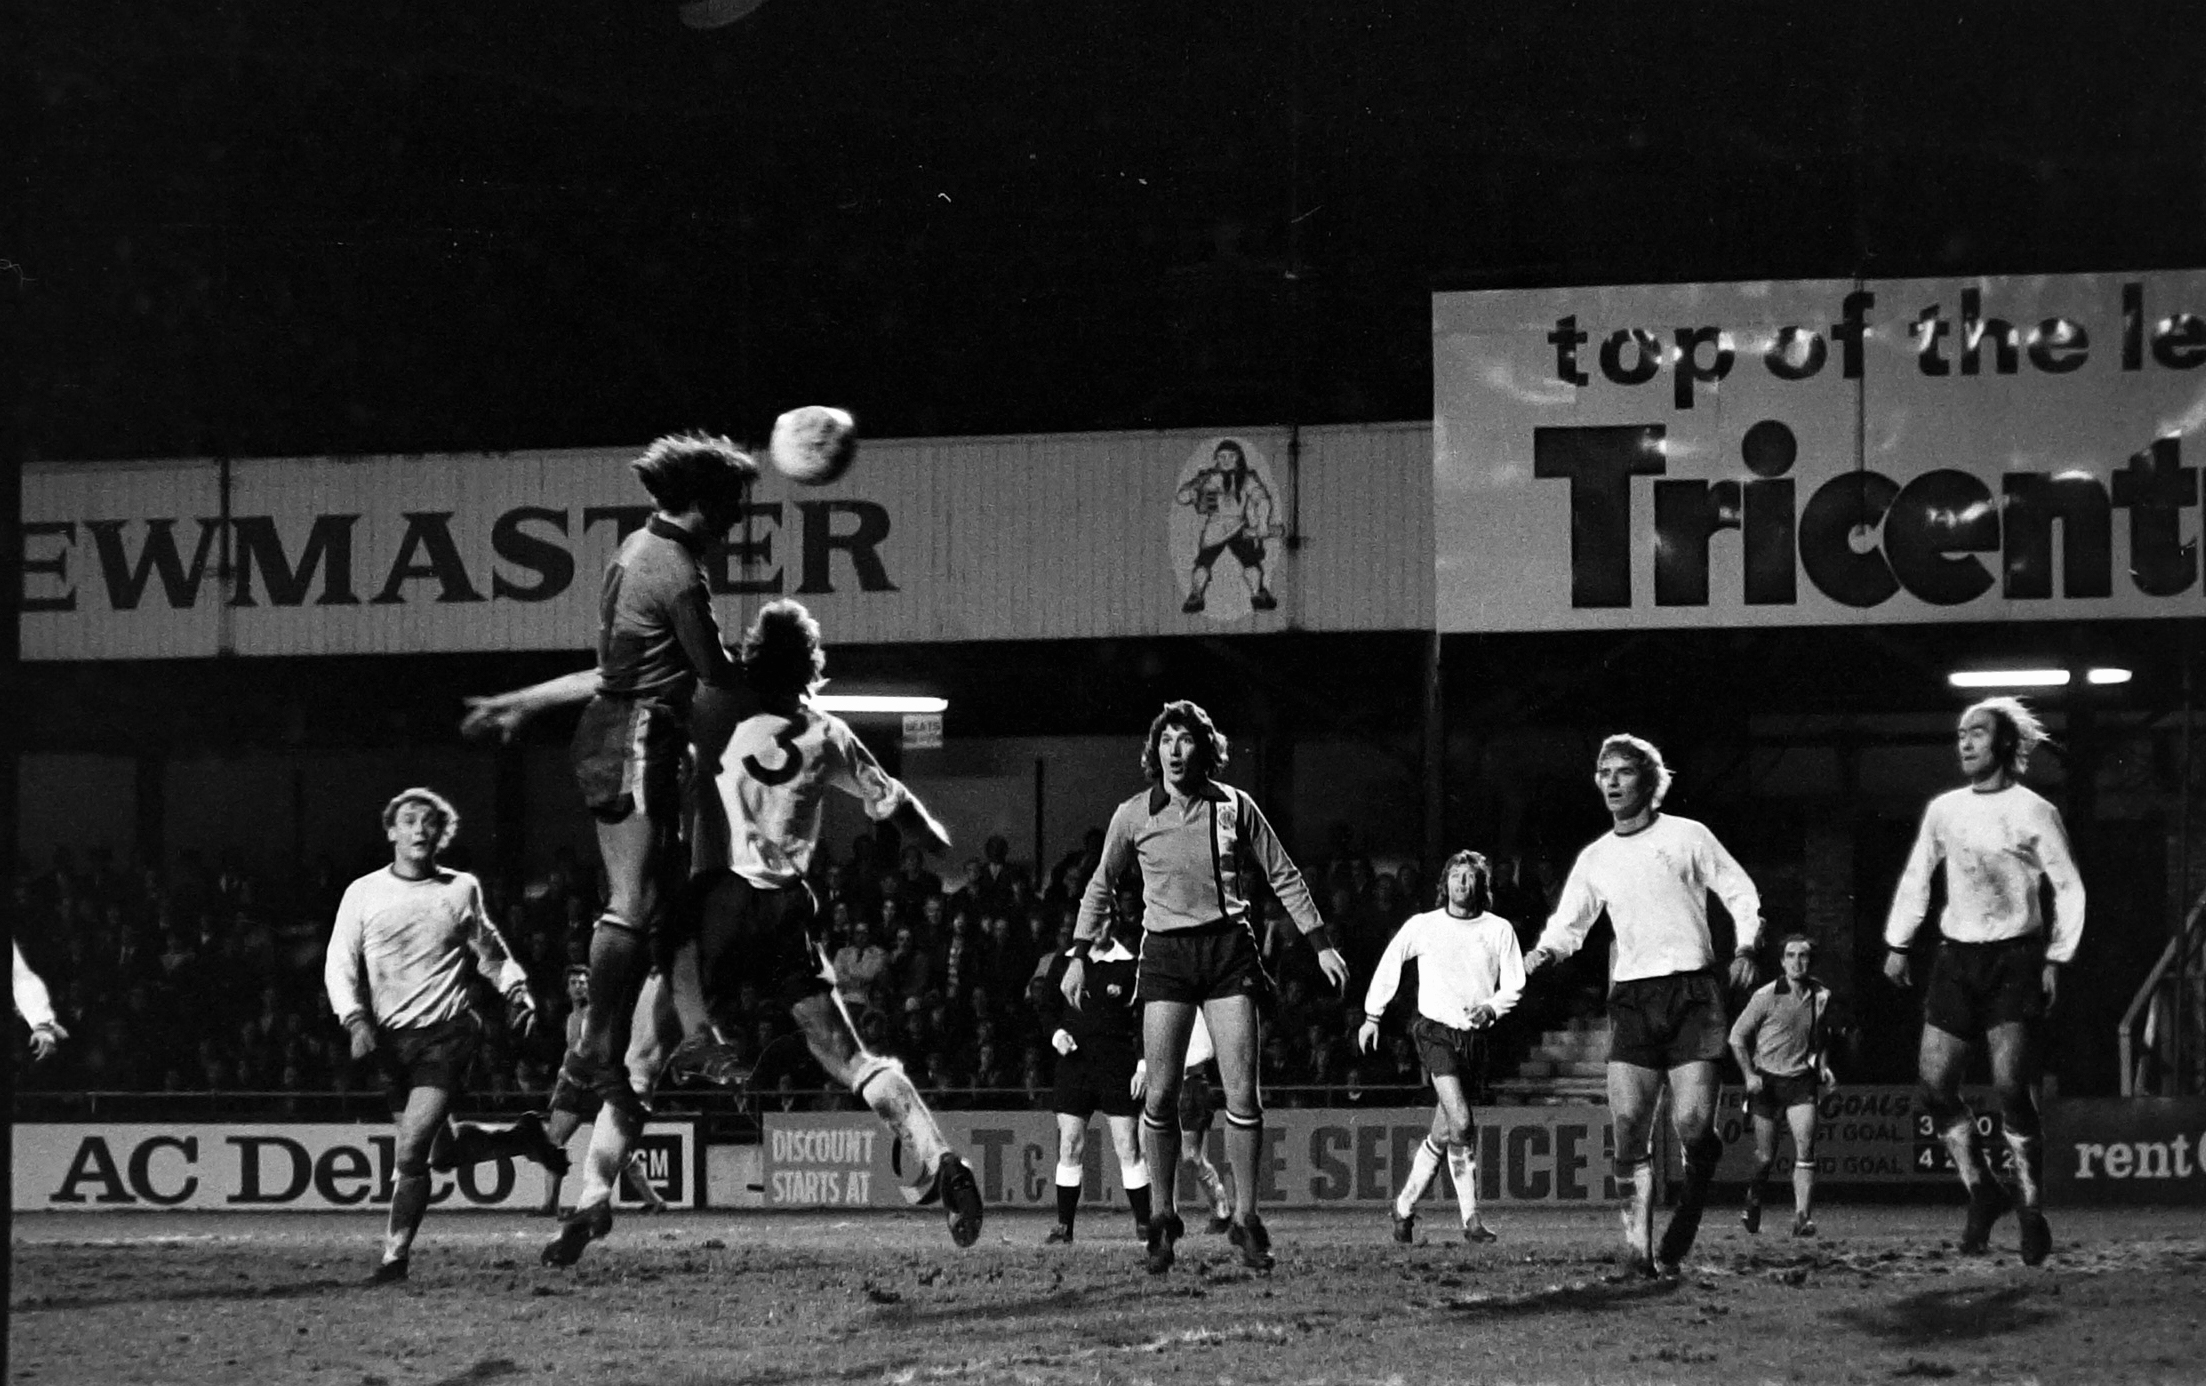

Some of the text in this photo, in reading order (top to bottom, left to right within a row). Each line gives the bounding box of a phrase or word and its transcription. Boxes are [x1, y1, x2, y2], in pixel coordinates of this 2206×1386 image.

[1548, 314, 1736, 410] top
[1764, 290, 1876, 381] of
[1908, 287, 2090, 377] the
[1534, 420, 2206, 608] Tricent
[741, 711, 808, 787] 3
[1820, 1091, 1911, 1119] GOALS
[770, 1129, 876, 1163] DISCOUNT
[1843, 1123, 1905, 1142] GOAL
[49, 1136, 199, 1205] AC
[1843, 1156, 1904, 1175] GOAL
[2074, 1133, 2194, 1179] rent
[770, 1170, 871, 1204] STARTS AT
